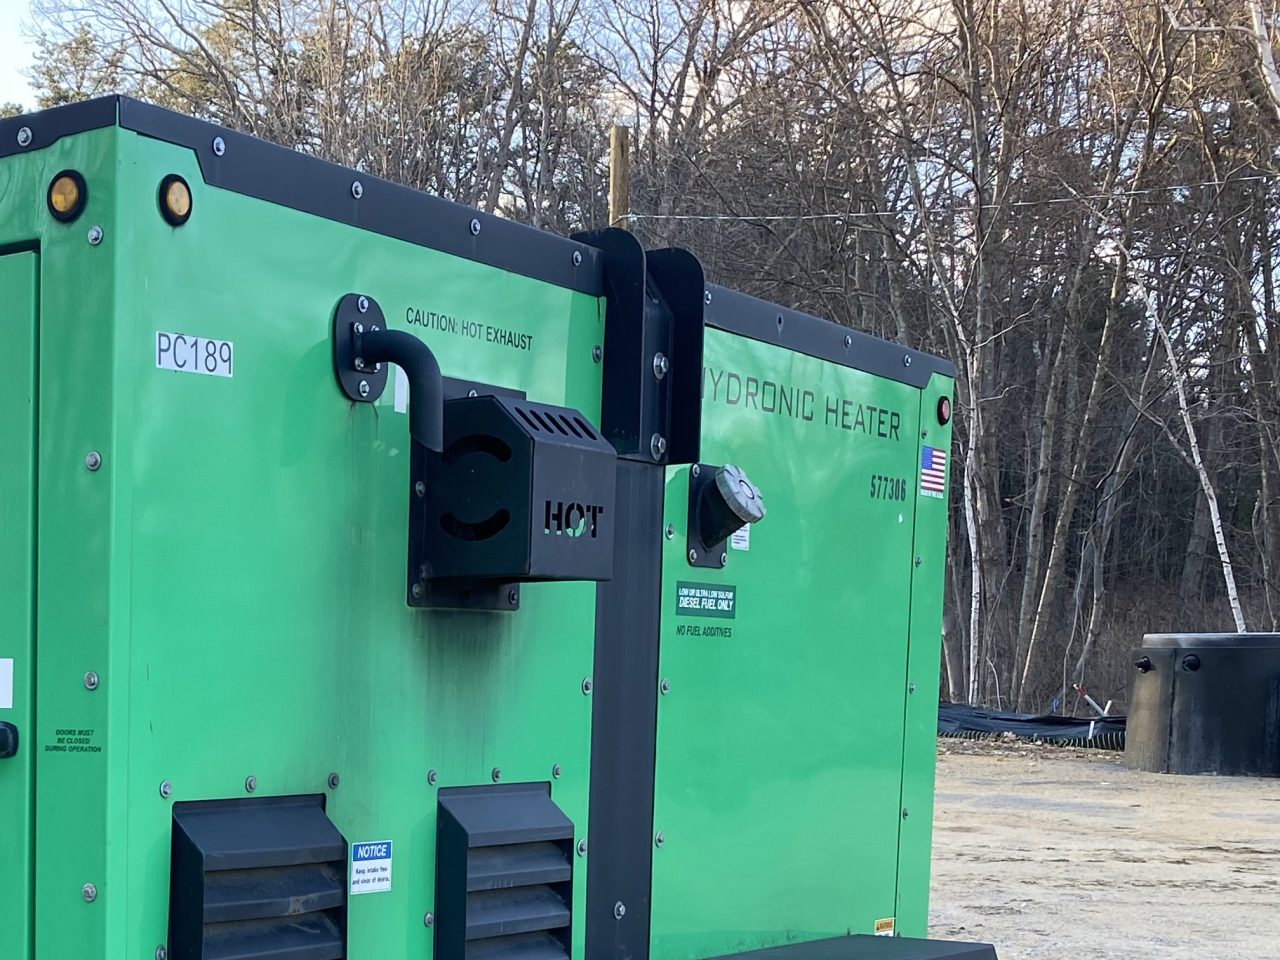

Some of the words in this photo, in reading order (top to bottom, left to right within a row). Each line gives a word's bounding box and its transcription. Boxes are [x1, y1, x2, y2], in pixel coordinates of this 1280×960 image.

[406, 307, 458, 334] CAUTION:
[461, 320, 483, 340] HOT
[486, 326, 533, 351] EXHAUST
[158, 332, 232, 375] PC189
[825, 396, 900, 441] HEATER
[869, 474, 906, 502] 577306
[544, 499, 604, 539] HOT
[679, 597, 700, 609] DIESEL
[701, 598, 717, 610] FUEL
[717, 599, 734, 611] ONLY
[676, 625, 686, 636] NO
[686, 625, 701, 637] FUEL
[702, 626, 732, 638] ADDITIVES
[357, 844, 387, 858] NOTICE
